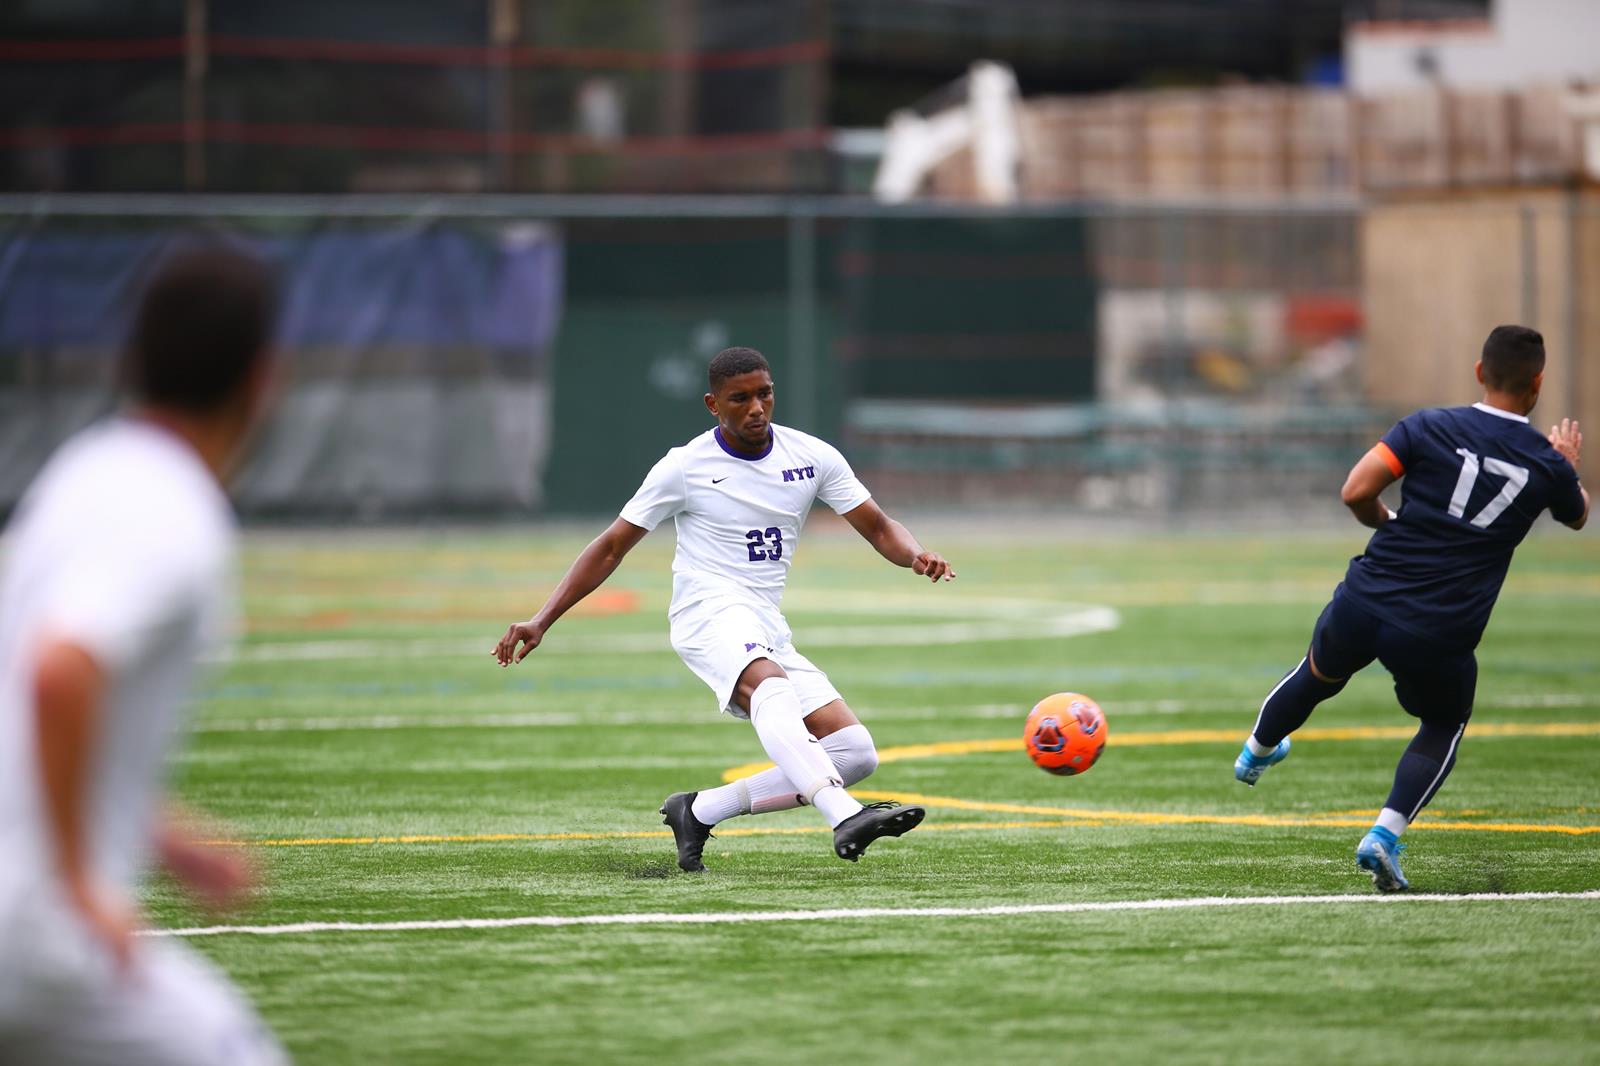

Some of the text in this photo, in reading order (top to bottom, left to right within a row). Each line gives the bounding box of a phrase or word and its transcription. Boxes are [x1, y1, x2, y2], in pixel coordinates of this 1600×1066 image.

[782, 466, 815, 483] NYU
[1447, 448, 1529, 529] 17
[745, 526, 783, 562] 23
